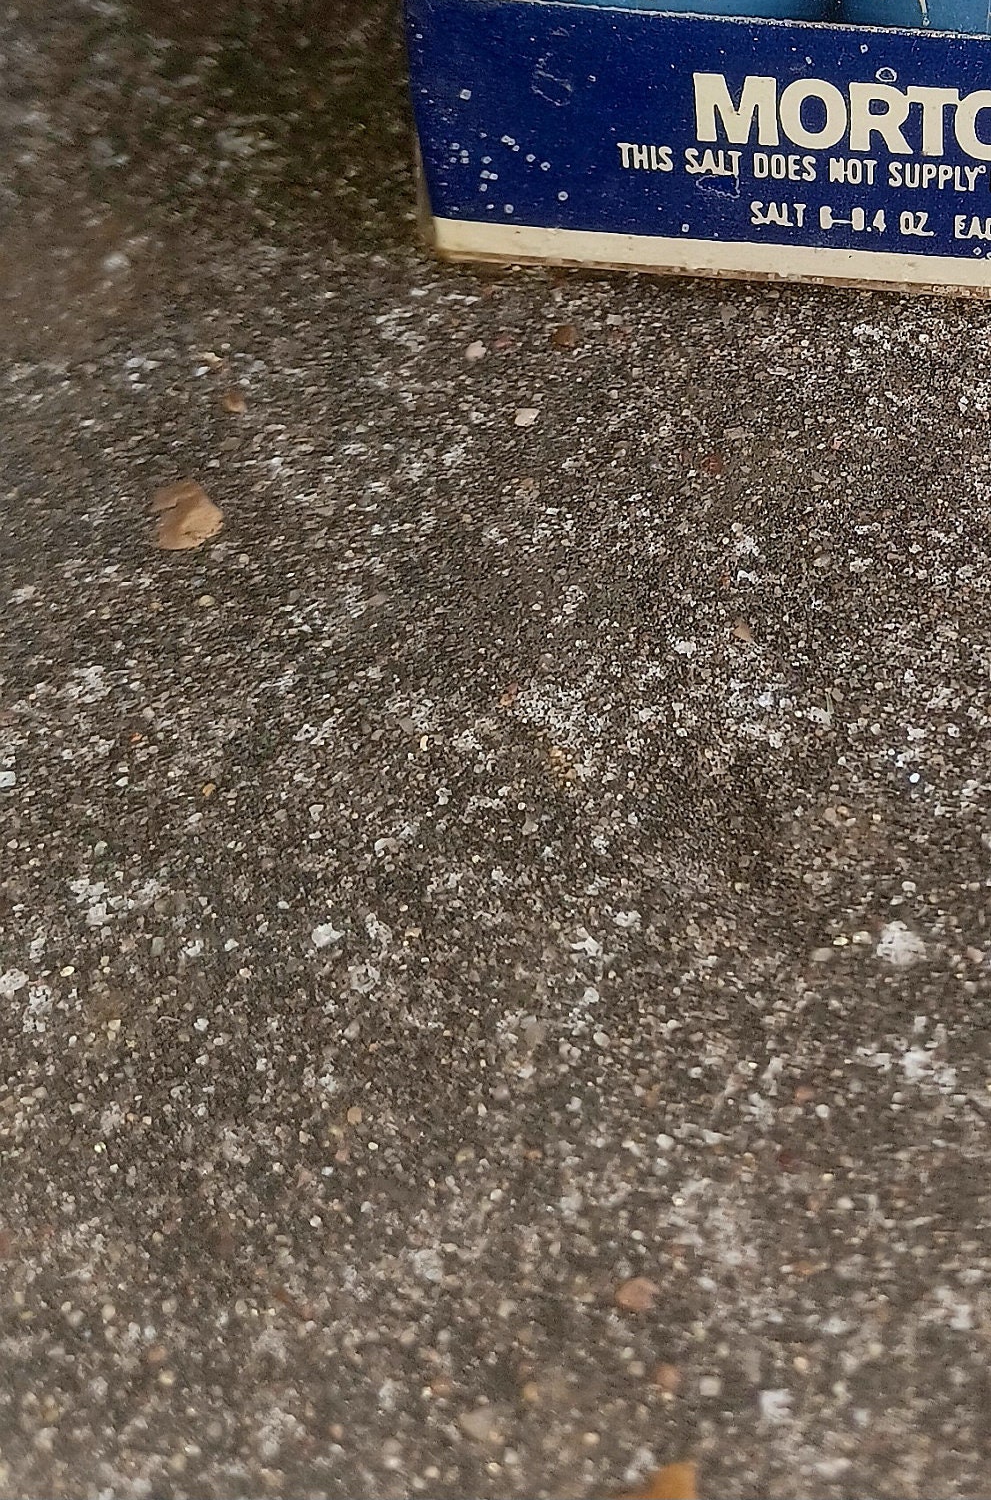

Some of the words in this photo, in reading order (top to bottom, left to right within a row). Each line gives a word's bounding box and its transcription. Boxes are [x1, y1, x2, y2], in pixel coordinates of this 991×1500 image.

[616, 142, 674, 172] THIS
[685, 146, 742, 176] SALT
[753, 152, 818, 182] DOES
[829, 157, 877, 185] NOT
[888, 162, 978, 192] SUPPLY
[750, 200, 807, 228] SALT
[900, 211, 935, 238] OZ.
